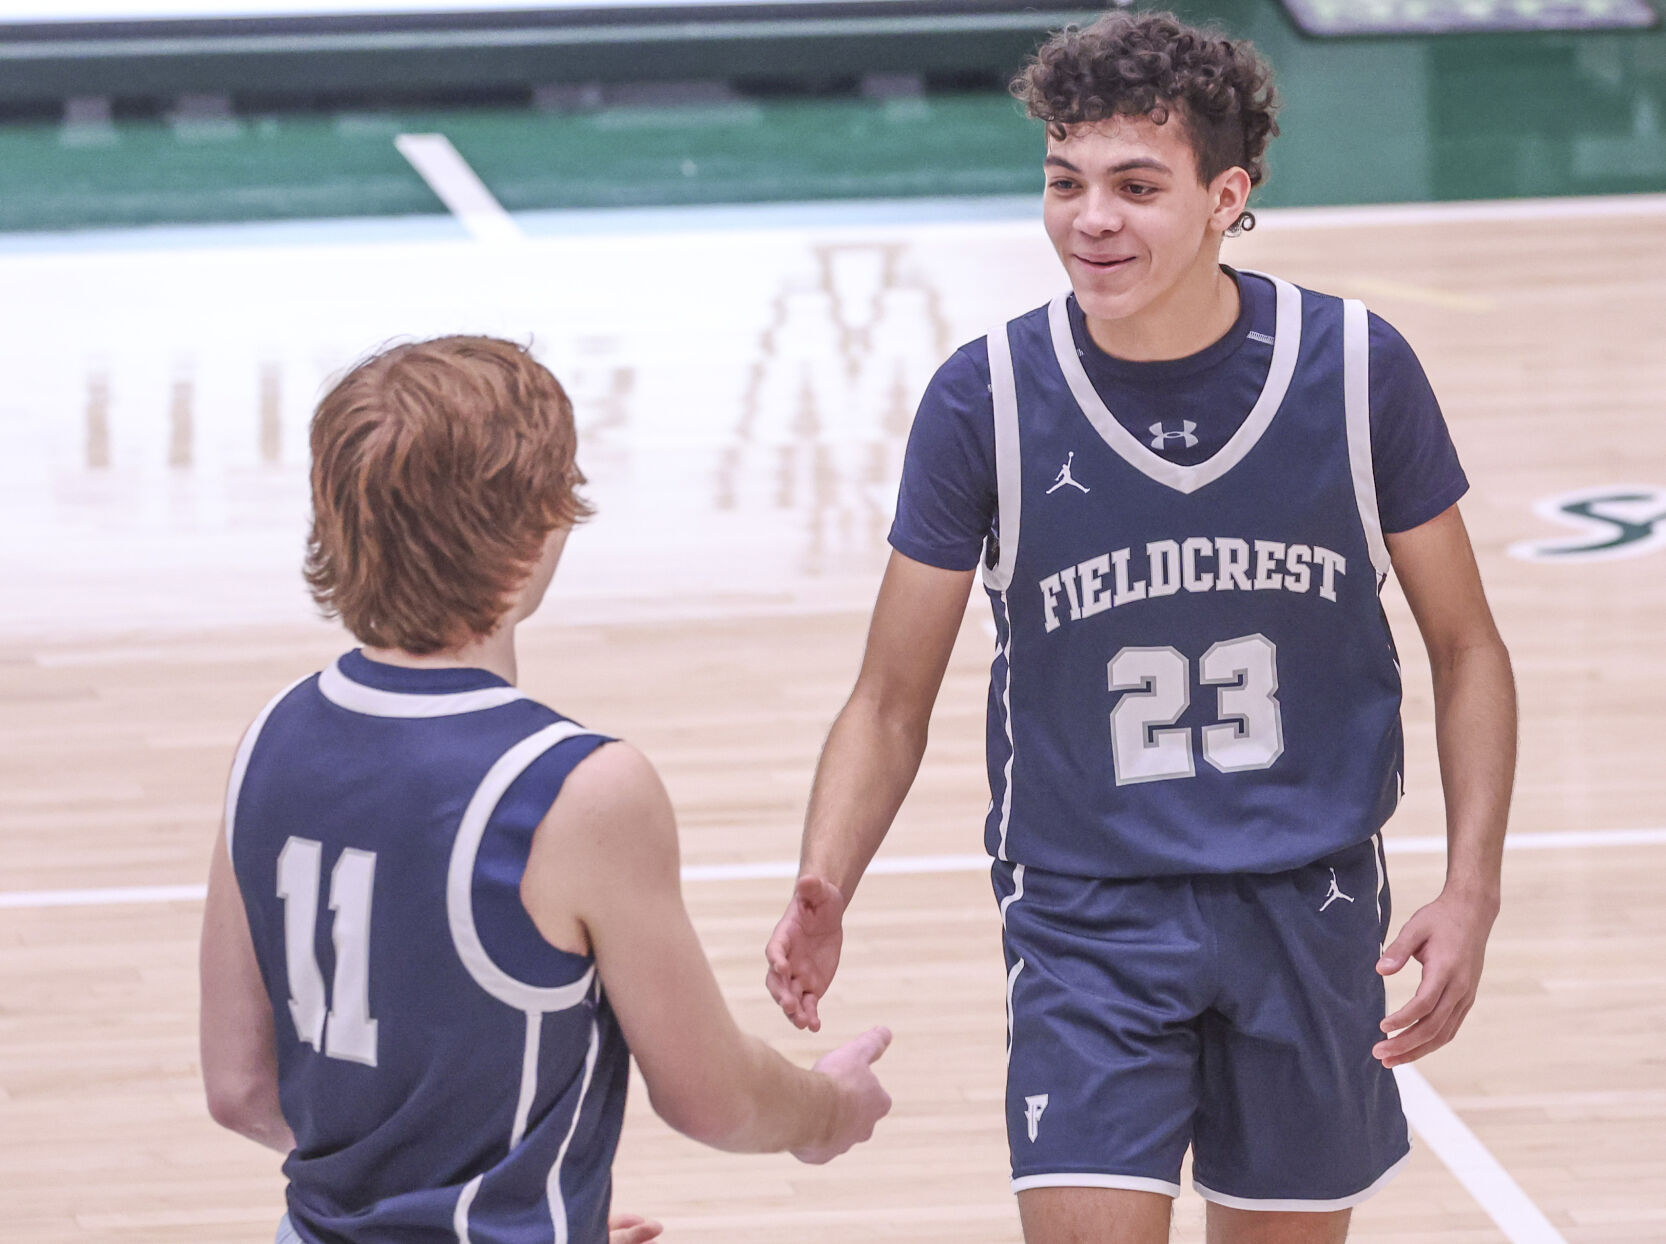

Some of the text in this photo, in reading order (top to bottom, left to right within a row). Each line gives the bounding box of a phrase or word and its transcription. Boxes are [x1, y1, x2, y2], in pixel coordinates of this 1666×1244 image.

[1039, 536, 1347, 634] FIELDCREST
[1107, 632, 1285, 787] 23
[276, 835, 379, 1068] 11
